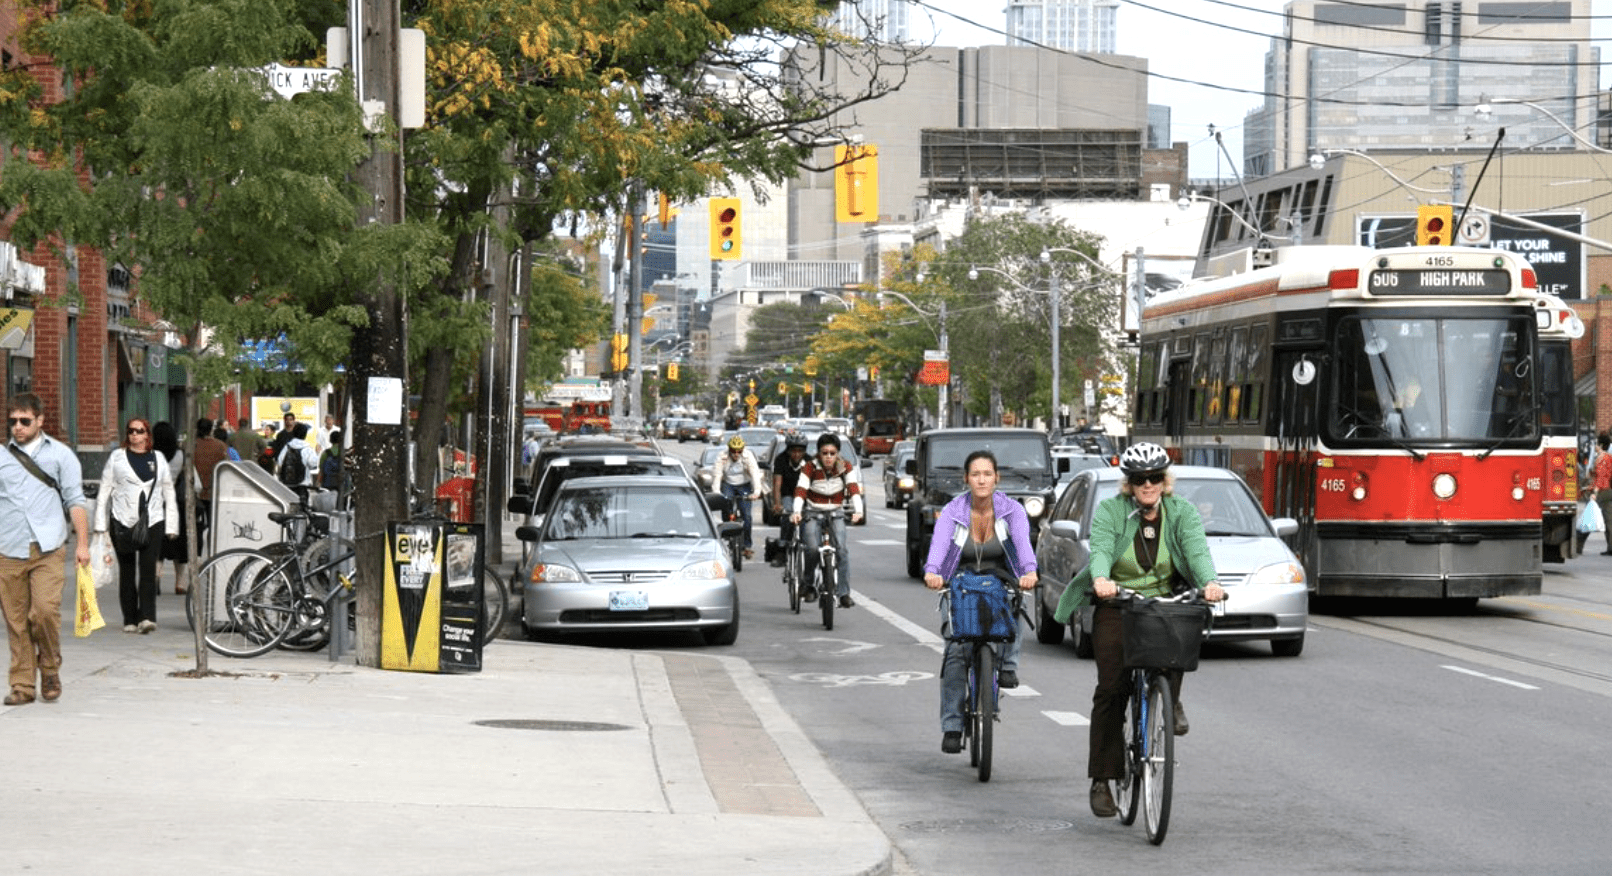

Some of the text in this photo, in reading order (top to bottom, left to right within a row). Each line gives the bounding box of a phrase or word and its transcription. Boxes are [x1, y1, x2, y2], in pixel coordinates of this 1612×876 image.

[1490, 240, 1550, 251] LET YOUR
[1425, 257, 1454, 266] 4165
[1528, 252, 1566, 263] SHINE
[1373, 271, 1486, 287] 506 HIGH PARK
[1321, 478, 1346, 492] 4165
[1526, 477, 1541, 490] 4165
